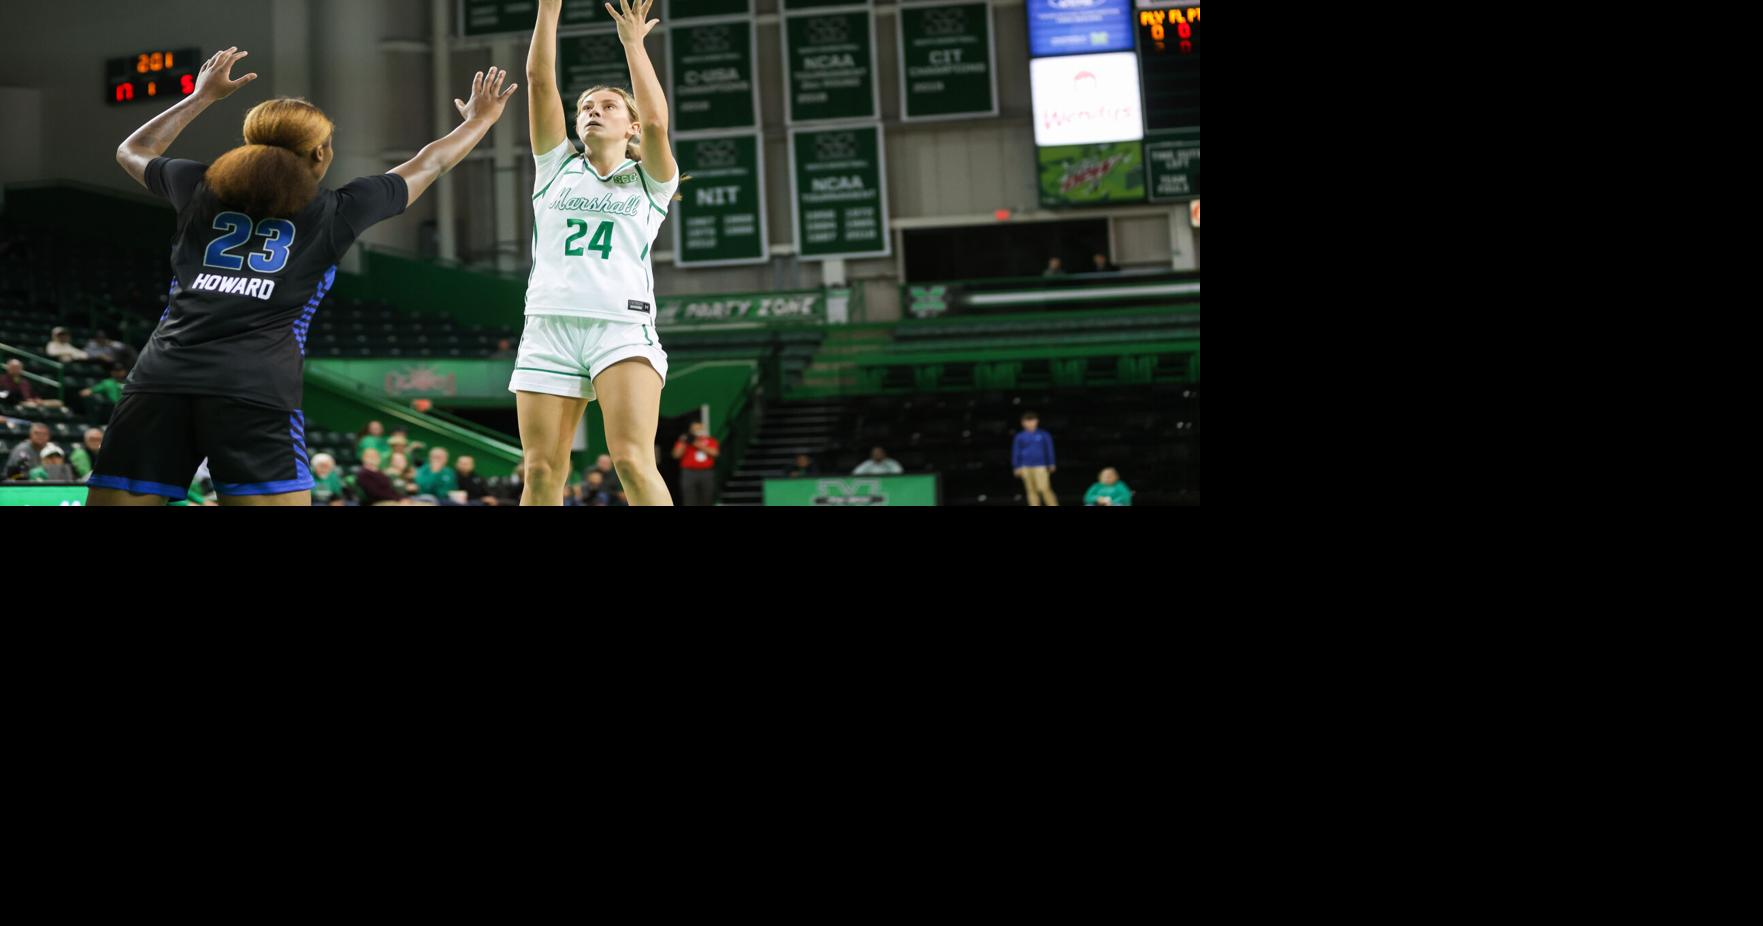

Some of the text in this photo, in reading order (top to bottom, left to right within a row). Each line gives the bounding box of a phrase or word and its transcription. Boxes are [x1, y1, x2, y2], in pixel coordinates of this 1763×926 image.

[803, 53, 855, 70] NCAA
[696, 184, 742, 206] NIT
[811, 174, 865, 192] NCAA
[549, 187, 641, 216] Marshall
[203, 211, 296, 273] 23
[565, 218, 614, 260] 24
[192, 273, 275, 300] HOWARD
[685, 299, 752, 319] PARTY
[757, 294, 819, 317] ZONE
